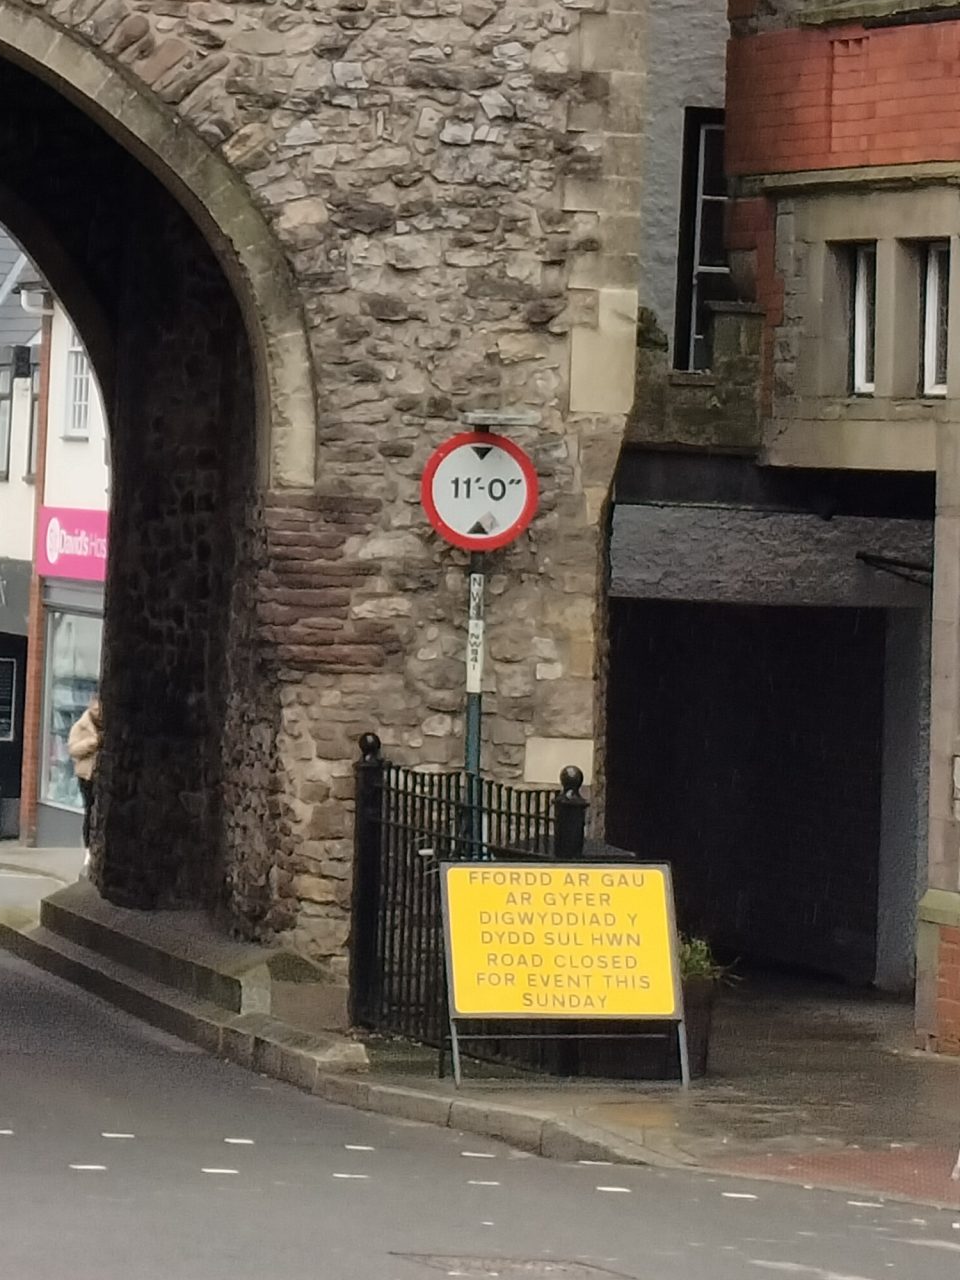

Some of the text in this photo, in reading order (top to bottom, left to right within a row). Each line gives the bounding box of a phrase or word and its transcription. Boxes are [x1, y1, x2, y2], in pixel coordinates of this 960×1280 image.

[89, 533, 107, 559] Hos
[468, 871, 645, 888] FFORDD AR GAU
[506, 891, 612, 907] AR GYFER
[479, 911, 638, 927] DIGWYDDIAD Y
[481, 930, 641, 947] DYDD SUL HWN
[487, 953, 638, 969] ROAD CLOSED
[476, 972, 651, 990] FOR EVENT THIS
[522, 992, 608, 1009] SUNDAY
